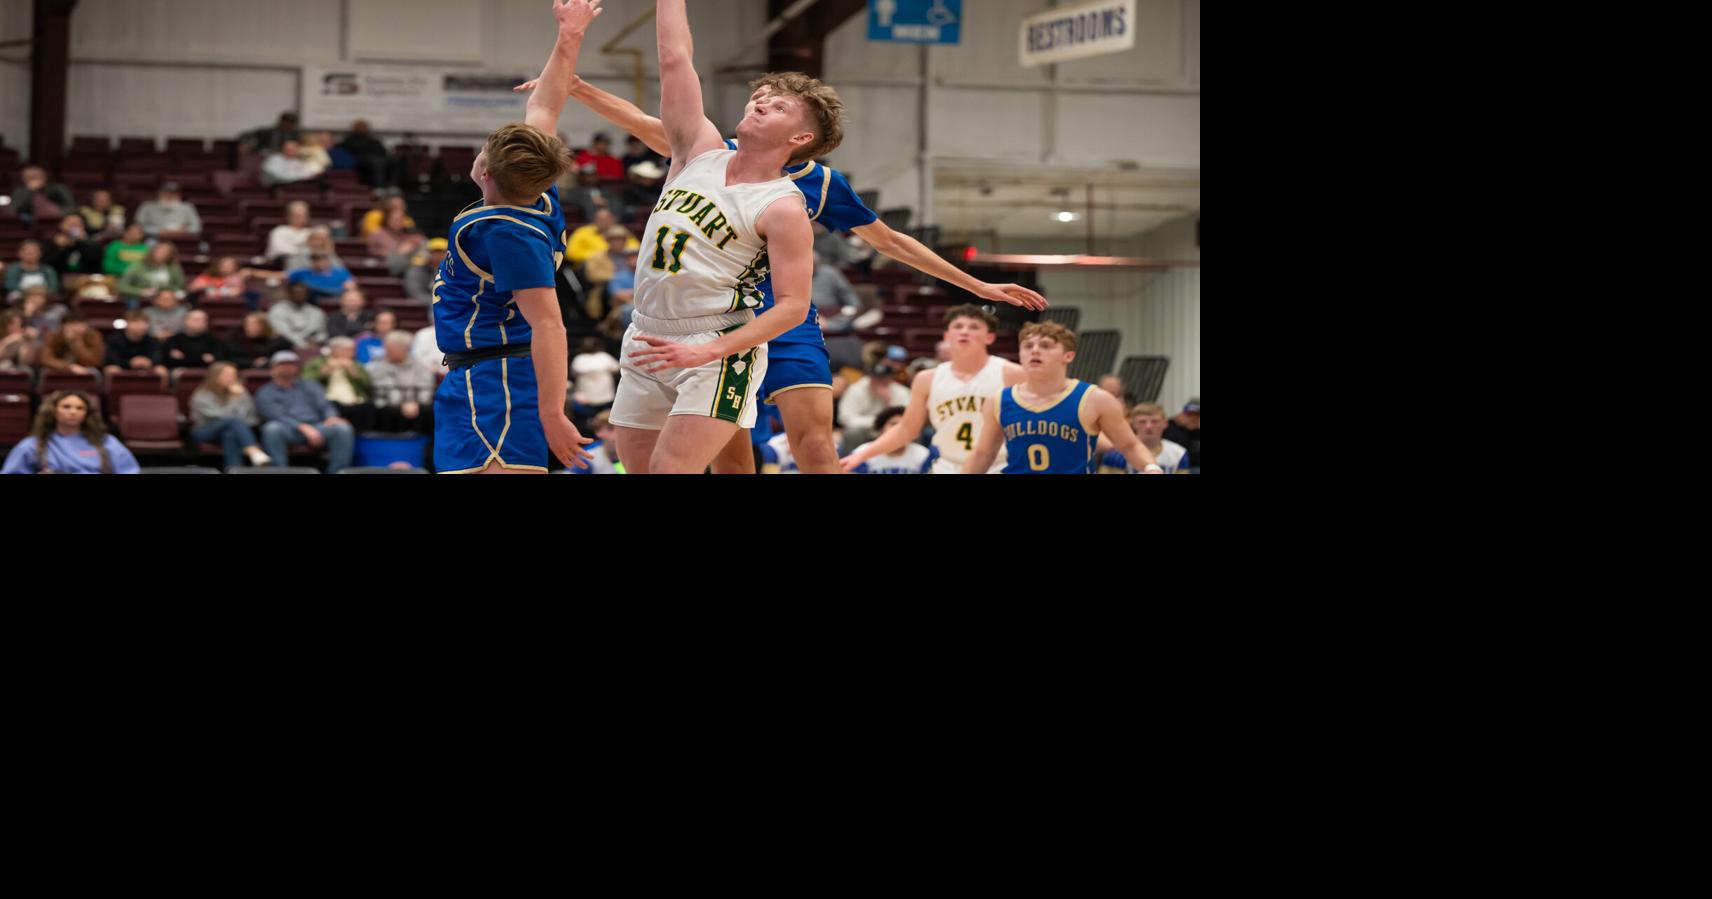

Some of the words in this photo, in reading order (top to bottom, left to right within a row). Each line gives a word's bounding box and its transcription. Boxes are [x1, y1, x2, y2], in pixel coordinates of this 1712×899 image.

[1027, 7, 1126, 52] RESTROOMS
[653, 188, 738, 250] STUART
[651, 225, 692, 276] 11
[956, 422, 973, 451] 4
[1005, 420, 1079, 443] ULLDOGS
[1027, 443, 1050, 471] 0
